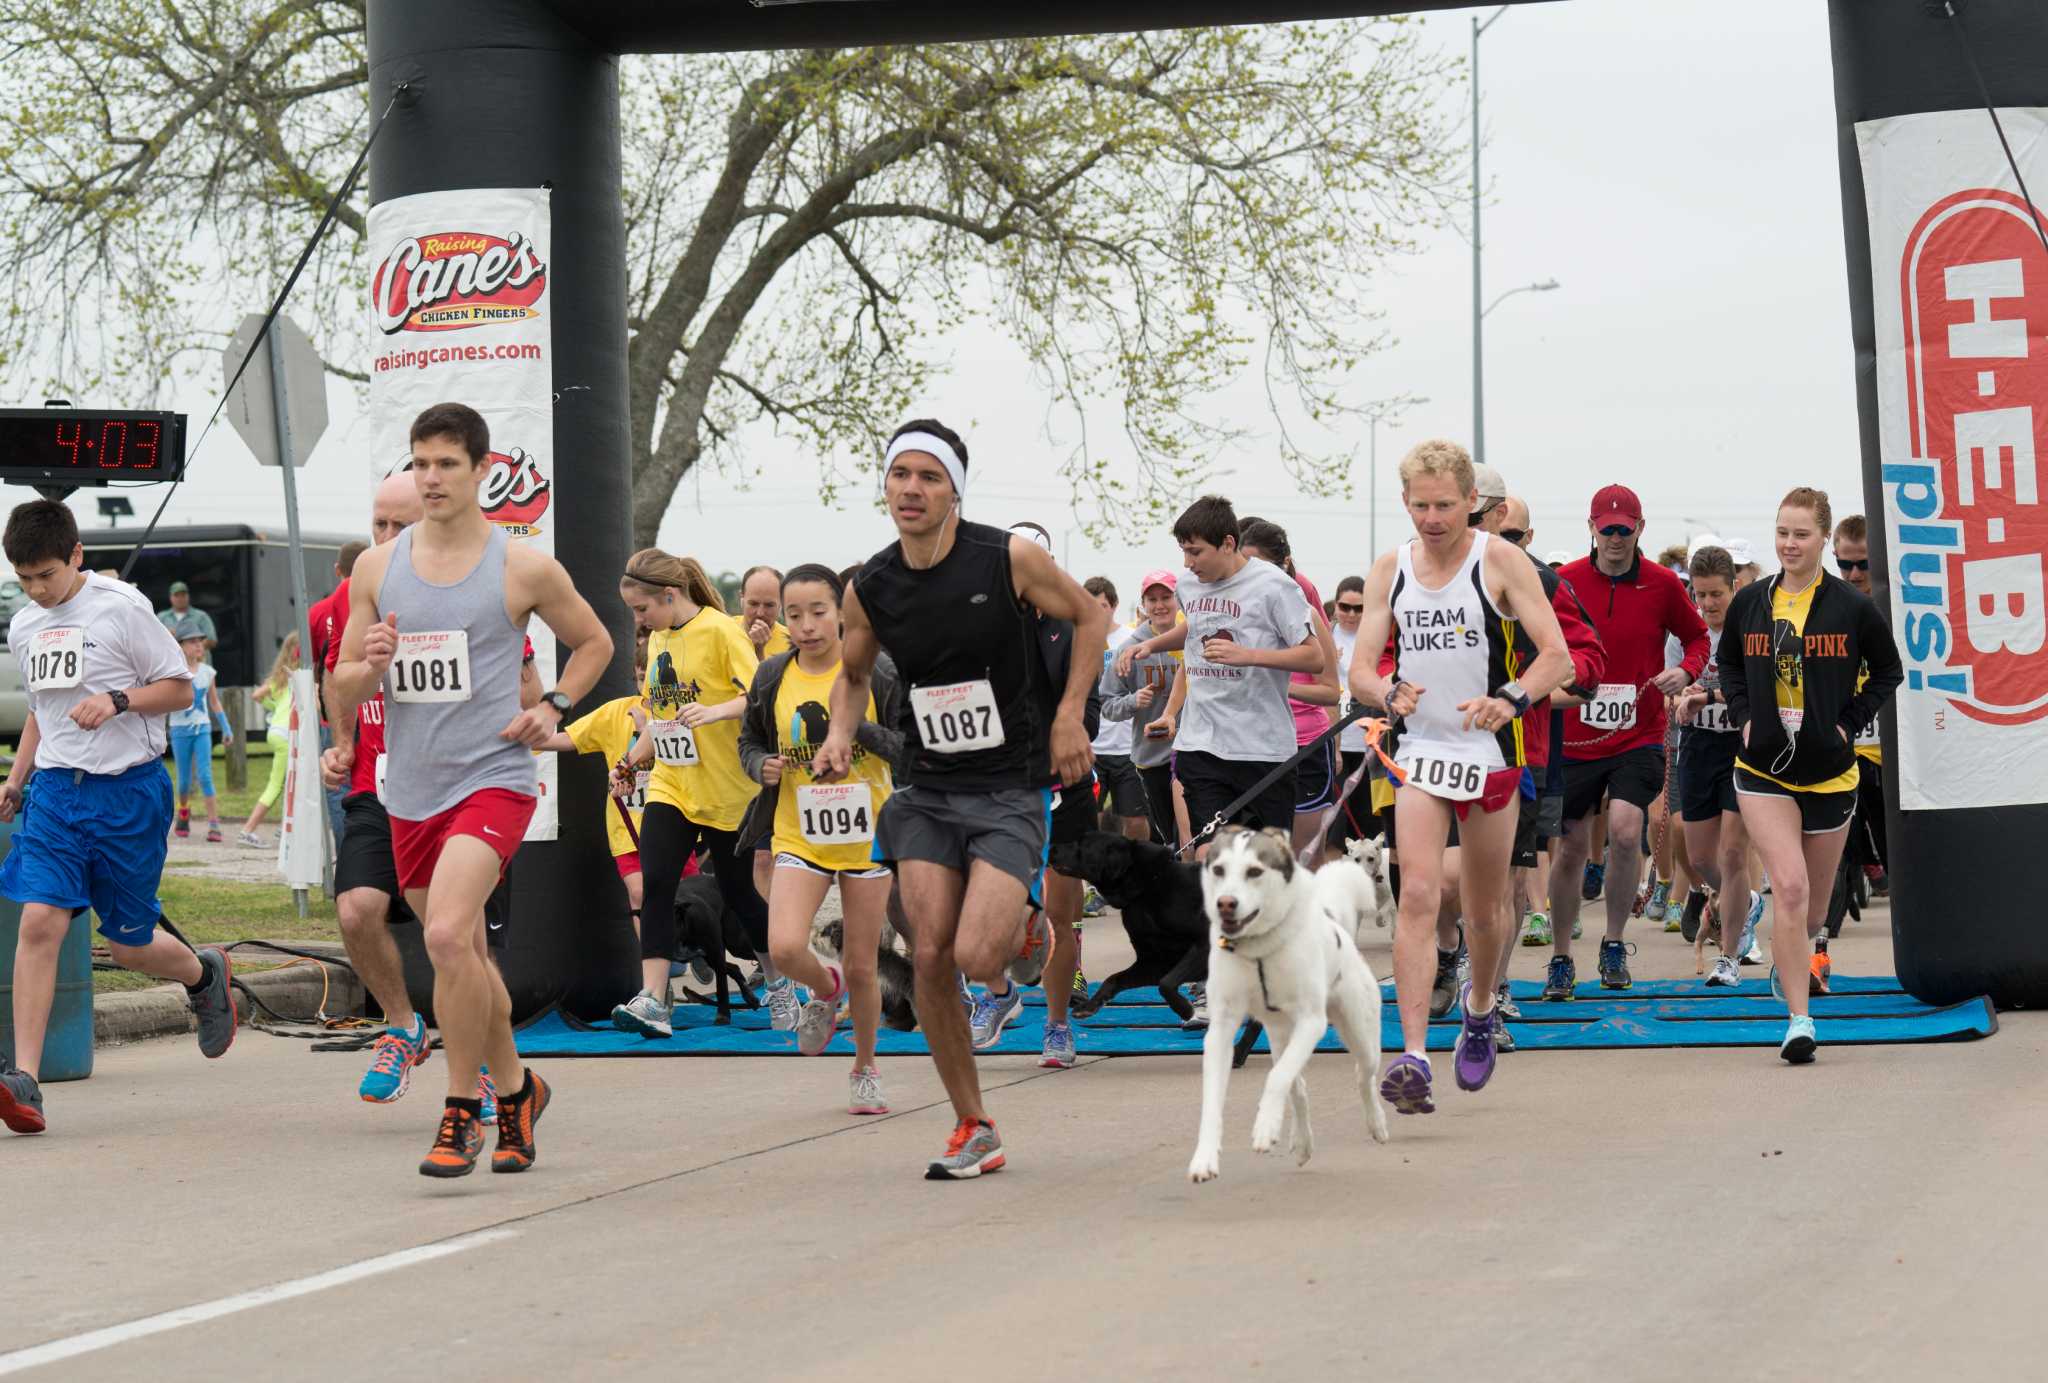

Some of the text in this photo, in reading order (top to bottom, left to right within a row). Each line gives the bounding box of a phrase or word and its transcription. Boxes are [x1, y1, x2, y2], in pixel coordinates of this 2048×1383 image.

[423, 236, 488, 257] Raising
[378, 231, 546, 335] Cane's
[374, 344, 541, 372] raisingcanes.com
[1882, 464, 1967, 694] plus!
[1185, 597, 1241, 619] PEARLAND
[1404, 606, 1466, 628] TEAM
[401, 635, 427, 643] FLEET
[1804, 633, 1848, 657] PINK
[31, 650, 77, 682] 1078
[394, 657, 462, 692] 1081
[1584, 701, 1633, 722] 1200
[1696, 709, 1729, 728] 114
[922, 705, 991, 744] 1087
[654, 736, 695, 759] 1172
[1411, 757, 1481, 793] 1096
[835, 786, 855, 794] FEET
[803, 807, 868, 836] 1094
